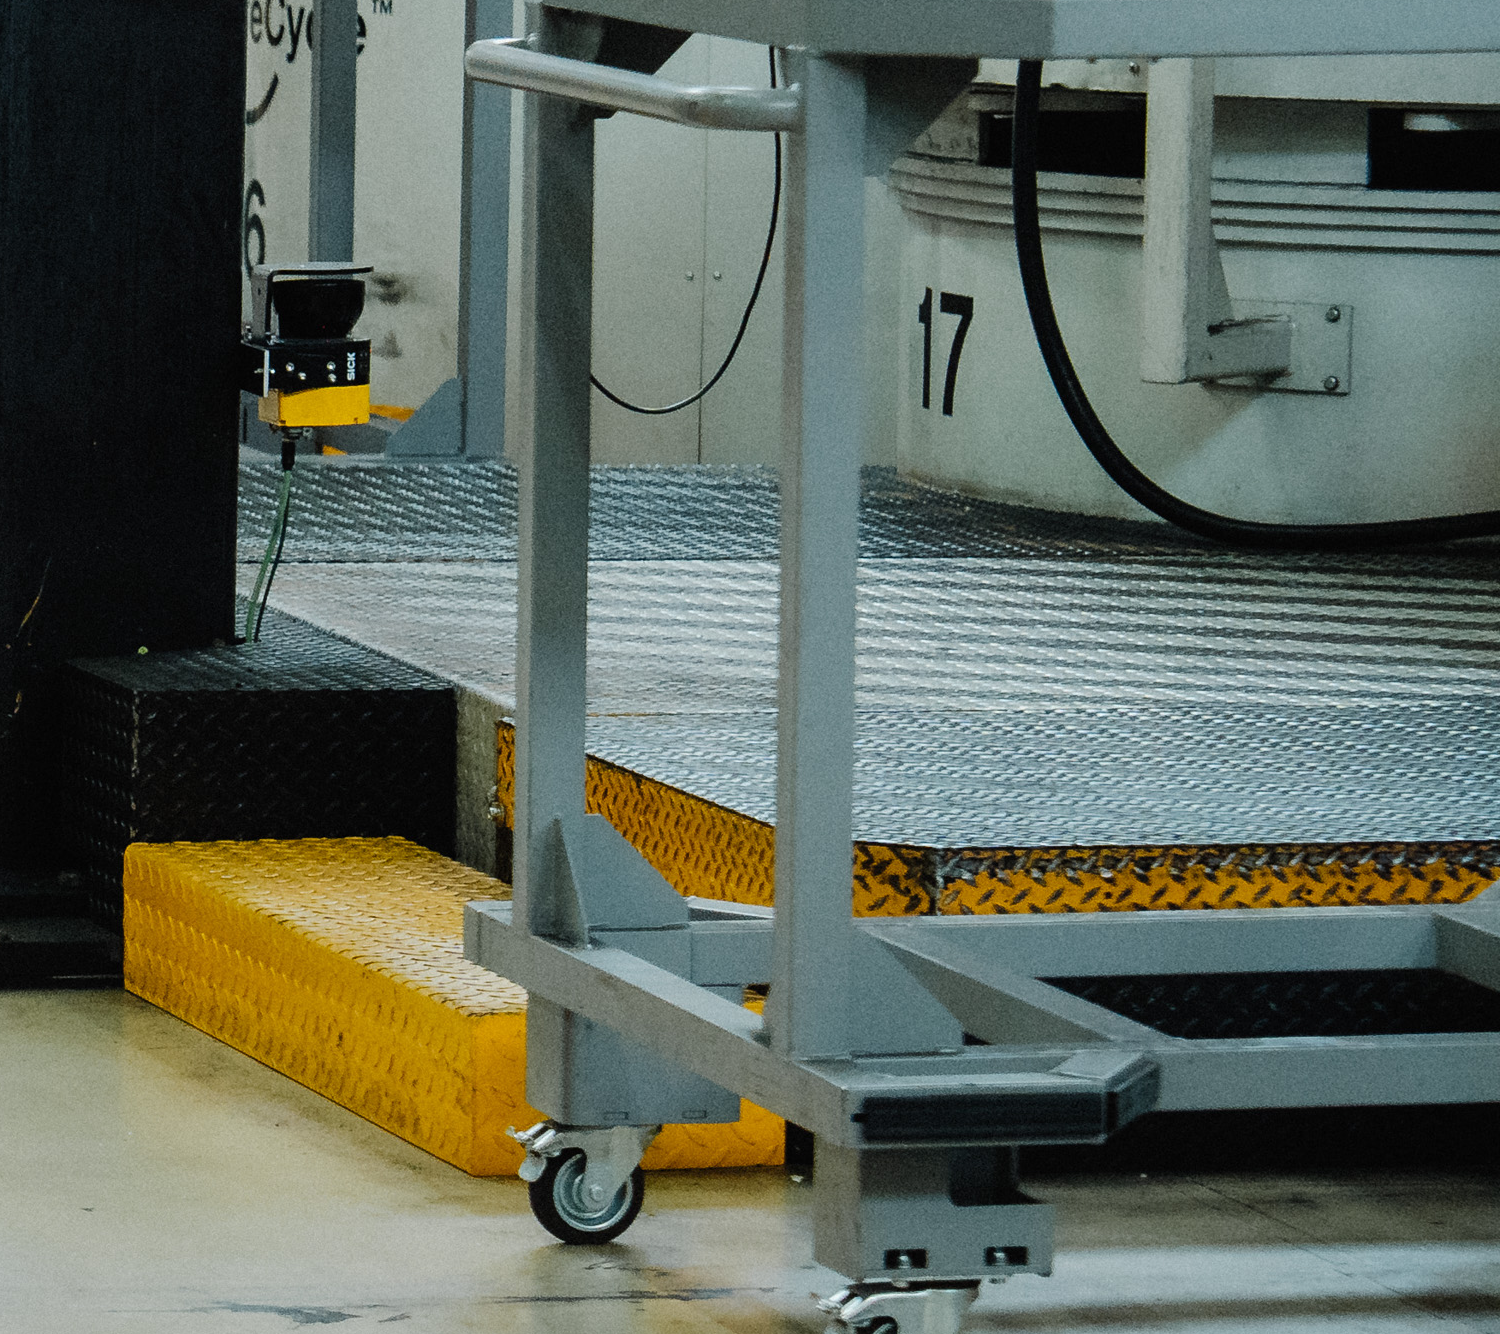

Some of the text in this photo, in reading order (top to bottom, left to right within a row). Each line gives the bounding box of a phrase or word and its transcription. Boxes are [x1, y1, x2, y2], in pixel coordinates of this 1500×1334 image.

[244, 178, 266, 280] 6
[347, 352, 356, 381] SICK
[918, 286, 974, 417] 17
